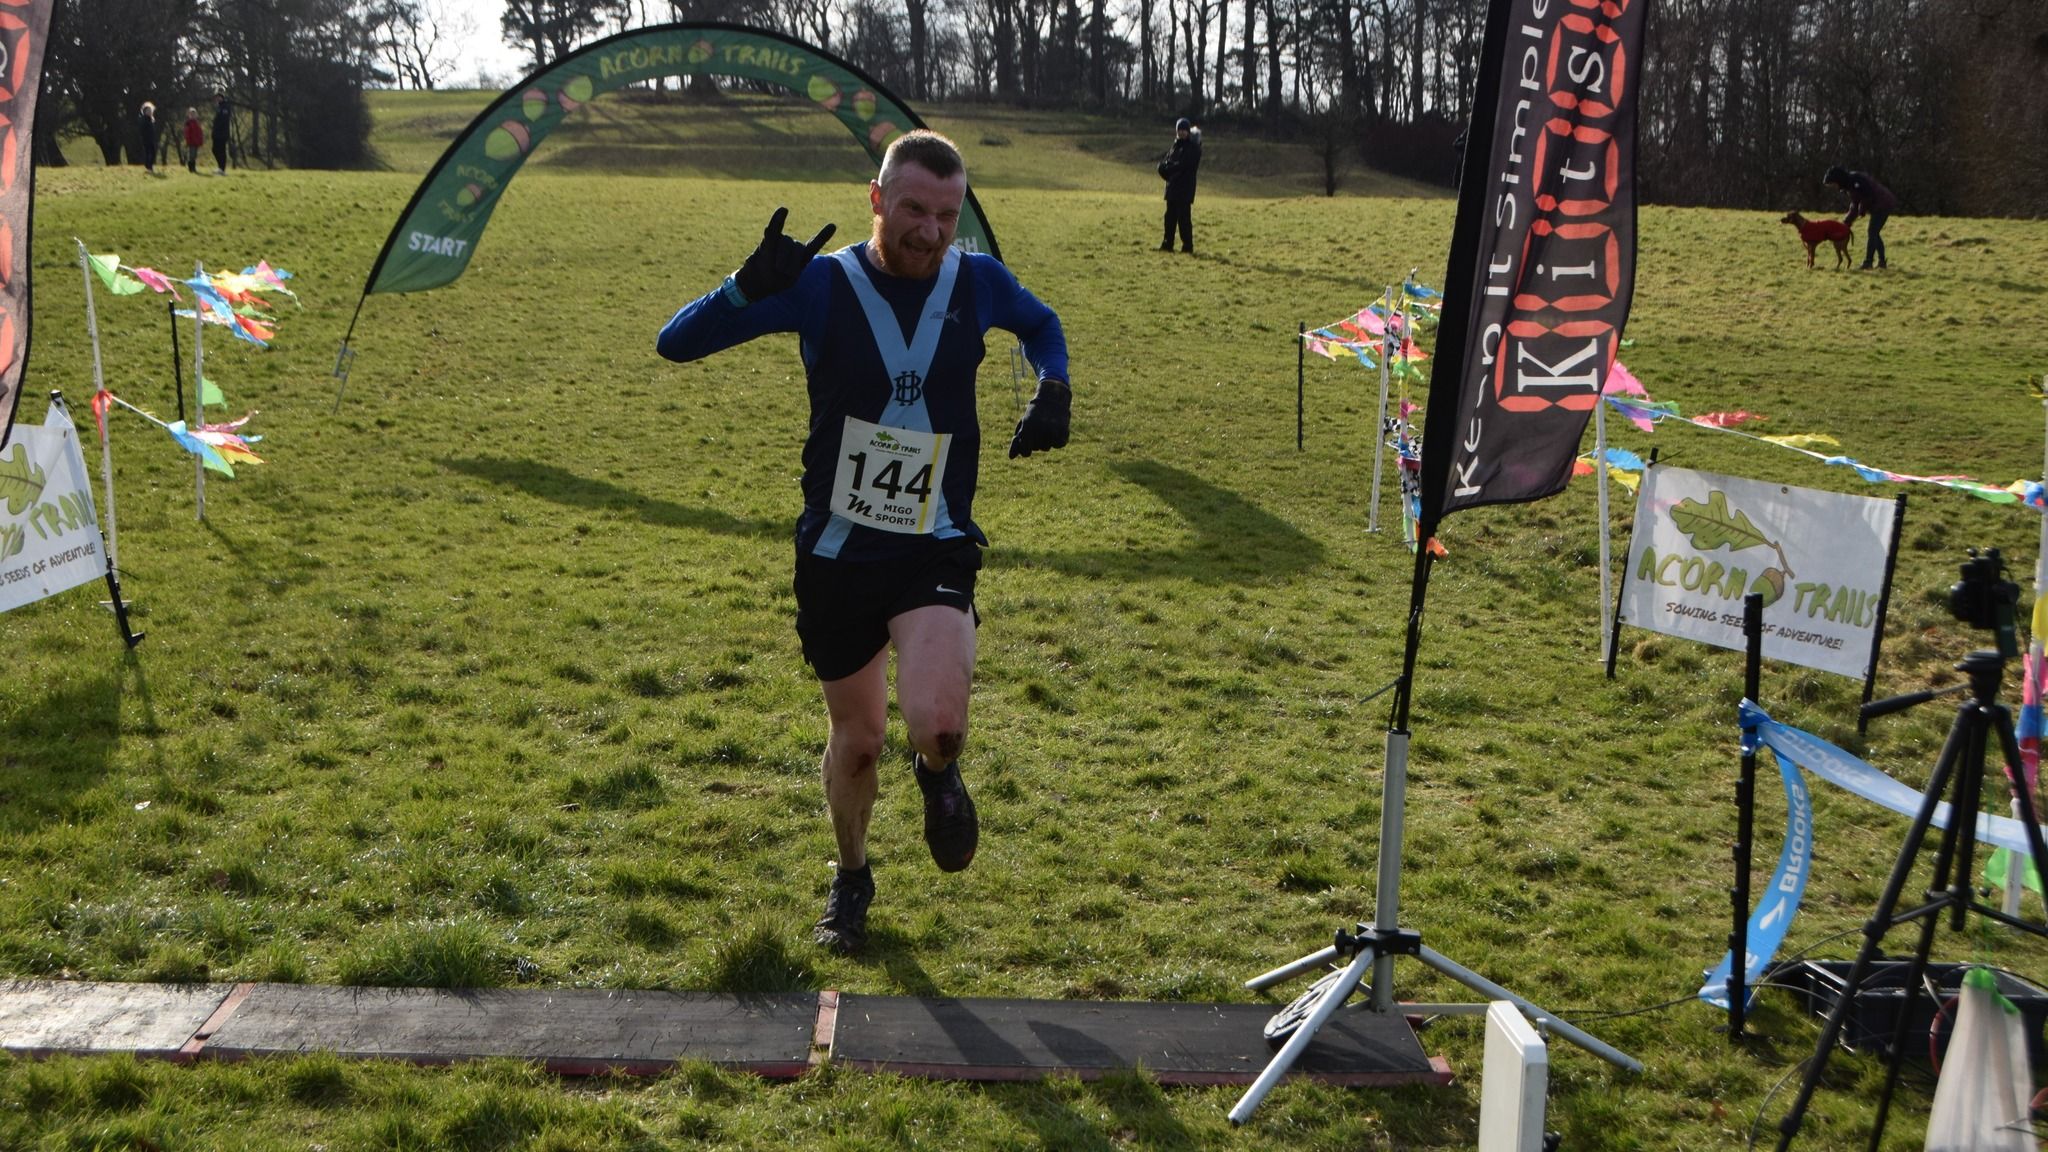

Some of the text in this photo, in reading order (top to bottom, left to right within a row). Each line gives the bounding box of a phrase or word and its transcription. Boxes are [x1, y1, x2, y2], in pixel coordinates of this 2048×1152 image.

[600, 44, 806, 79] ACORN TRAILS
[408, 231, 468, 257] START
[848, 451, 934, 504] 144
[875, 513, 917, 527] SPORTS
[883, 503, 913, 516] MIGO
[33, 558, 47, 575] OF
[1637, 545, 1880, 629] ACORN TRAILS
[1665, 601, 1718, 622] SOWING
[1776, 626, 1844, 650] ADVENTURE!
